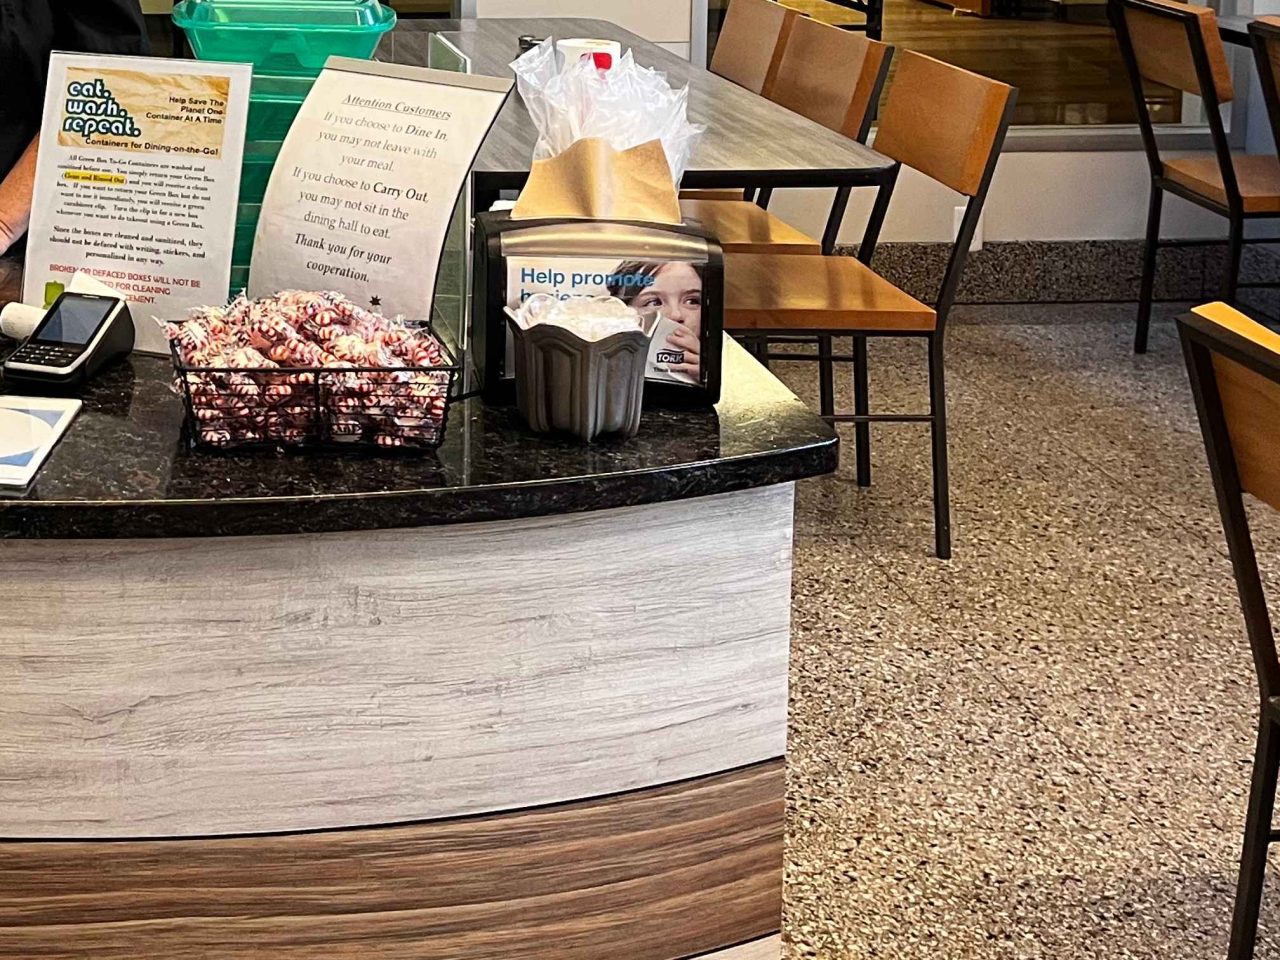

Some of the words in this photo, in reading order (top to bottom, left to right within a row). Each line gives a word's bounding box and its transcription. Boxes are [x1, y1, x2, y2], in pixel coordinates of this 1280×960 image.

[68, 79, 111, 97] eat.
[66, 98, 127, 117] wash.
[169, 96, 186, 105] Help
[189, 98, 207, 106] Save
[181, 106, 205, 114] Planet
[343, 94, 392, 110] Attention
[394, 101, 452, 120] Customers
[146, 112, 183, 121] Container
[63, 117, 141, 138] repeat.
[323, 111, 334, 121] If
[333, 115, 353, 125] you
[355, 117, 391, 131] choose
[392, 123, 403, 133] to
[405, 124, 433, 138] Dine
[434, 129, 449, 142] In,
[85, 138, 128, 148] Containers
[131, 141, 142, 149] for
[144, 143, 218, 155] Dining-on-the-Go!
[317, 131, 337, 141] you
[339, 133, 362, 148] may
[363, 139, 382, 149] not
[383, 140, 411, 154] leave
[413, 146, 437, 159] with
[339, 154, 365, 166] your
[367, 160, 395, 172] meal.
[292, 166, 301, 177] If
[300, 170, 321, 182] you
[324, 173, 358, 189] choose
[360, 180, 371, 190] to
[373, 181, 403, 200] Carry
[405, 188, 429, 203] Out,
[298, 191, 318, 203] you
[320, 195, 343, 209] may
[344, 200, 362, 211] not
[363, 202, 377, 214] sit
[379, 204, 389, 216] in
[391, 207, 409, 220] the
[304, 210, 337, 230] dining
[338, 217, 358, 232] hall
[360, 224, 371, 235] to
[373, 228, 391, 239] eat.
[84, 238, 91, 246] be
[93, 240, 117, 249] defaced
[119, 243, 134, 251] with
[163, 248, 190, 258] stickers,
[192, 251, 205, 259] and
[114, 231, 139, 240] cleaned
[188, 239, 203, 249] they
[295, 233, 326, 250] Thank
[327, 242, 347, 255] you
[347, 245, 365, 260] for
[366, 250, 392, 264] your
[85, 251, 126, 260] personalized
[136, 256, 148, 265] any
[93, 269, 126, 280] DEFACED
[128, 272, 151, 282] BOXES
[153, 276, 170, 284] WILL
[172, 278, 189, 286] NOT
[191, 280, 200, 288] BE
[306, 260, 370, 283] cooperation.
[521, 268, 565, 287] Help
[571, 271, 656, 287] promote
[116, 282, 131, 291] FOR
[132, 284, 170, 295] CLEANING
[658, 353, 683, 362] TORK
